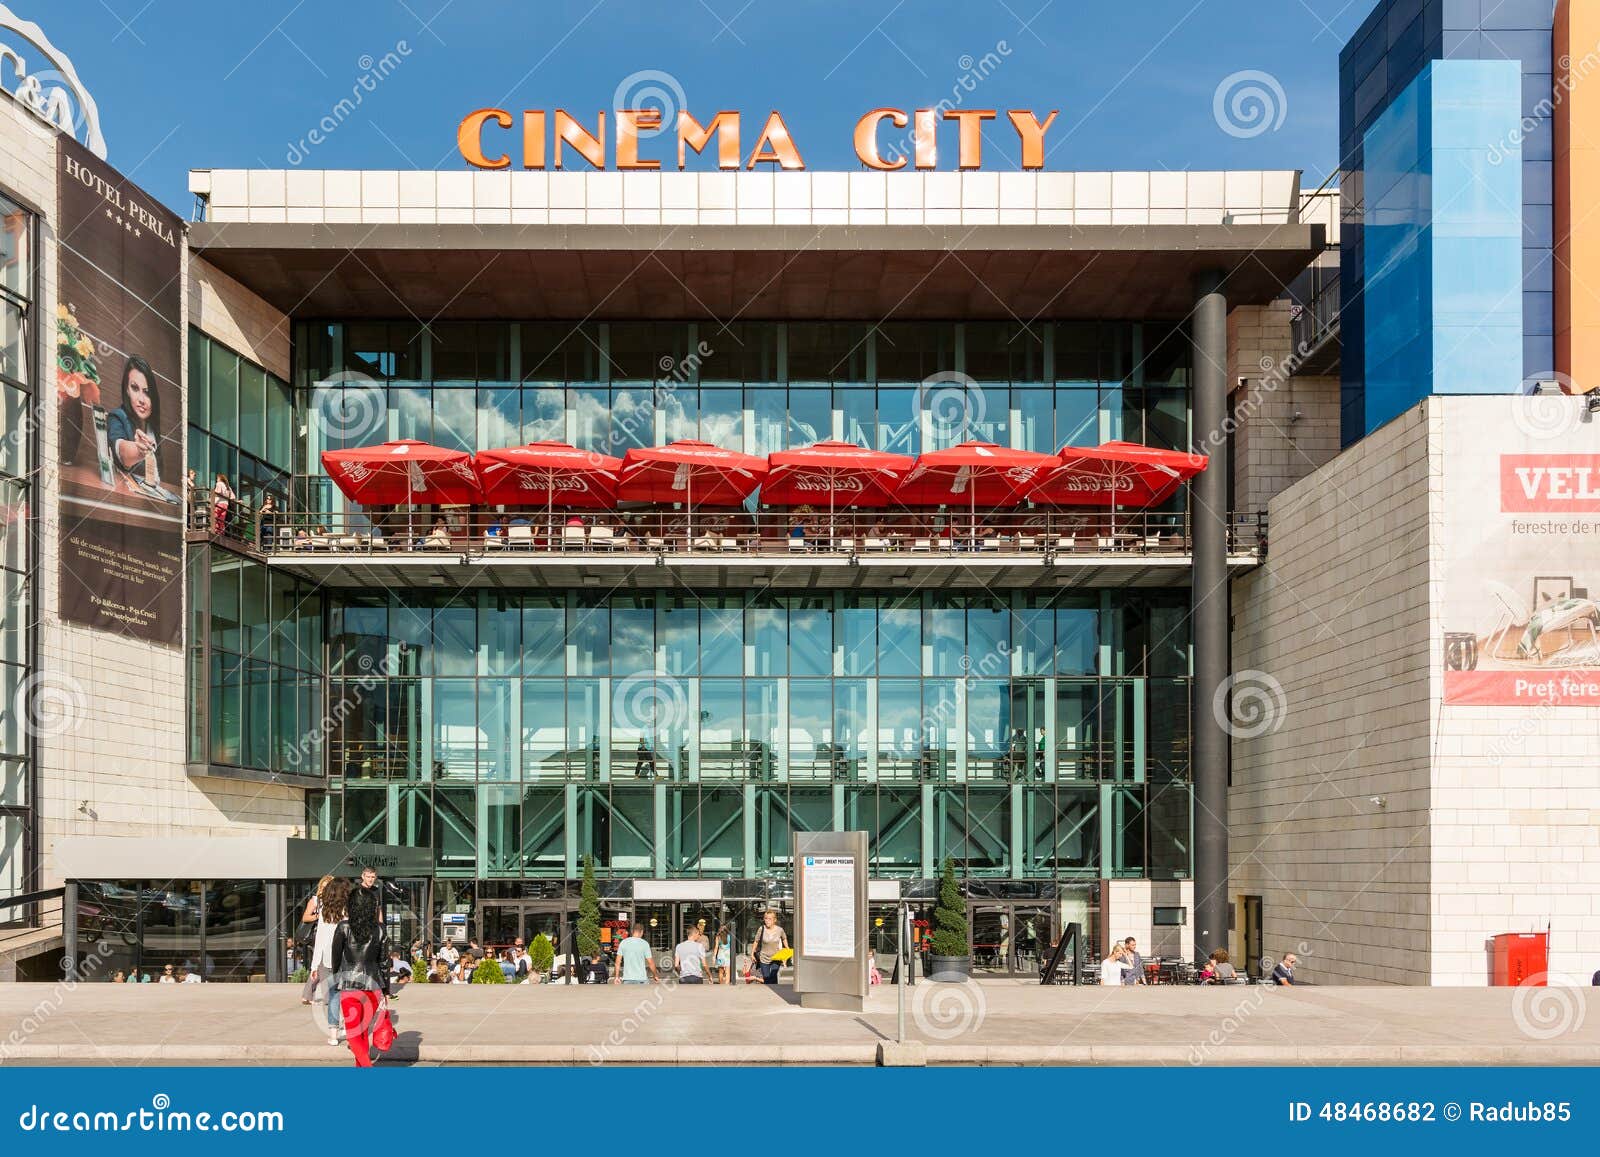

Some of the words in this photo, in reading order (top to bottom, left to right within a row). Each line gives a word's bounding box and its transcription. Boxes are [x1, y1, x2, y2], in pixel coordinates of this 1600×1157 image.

[457, 108, 806, 170] CINEMA
[853, 107, 1060, 171] CITY
[65, 154, 126, 212] HOTEL
[129, 199, 176, 248] PERLA
[1514, 467, 1600, 500] VEL
[1511, 519, 1568, 534] ferestre
[1571, 519, 1589, 534] de
